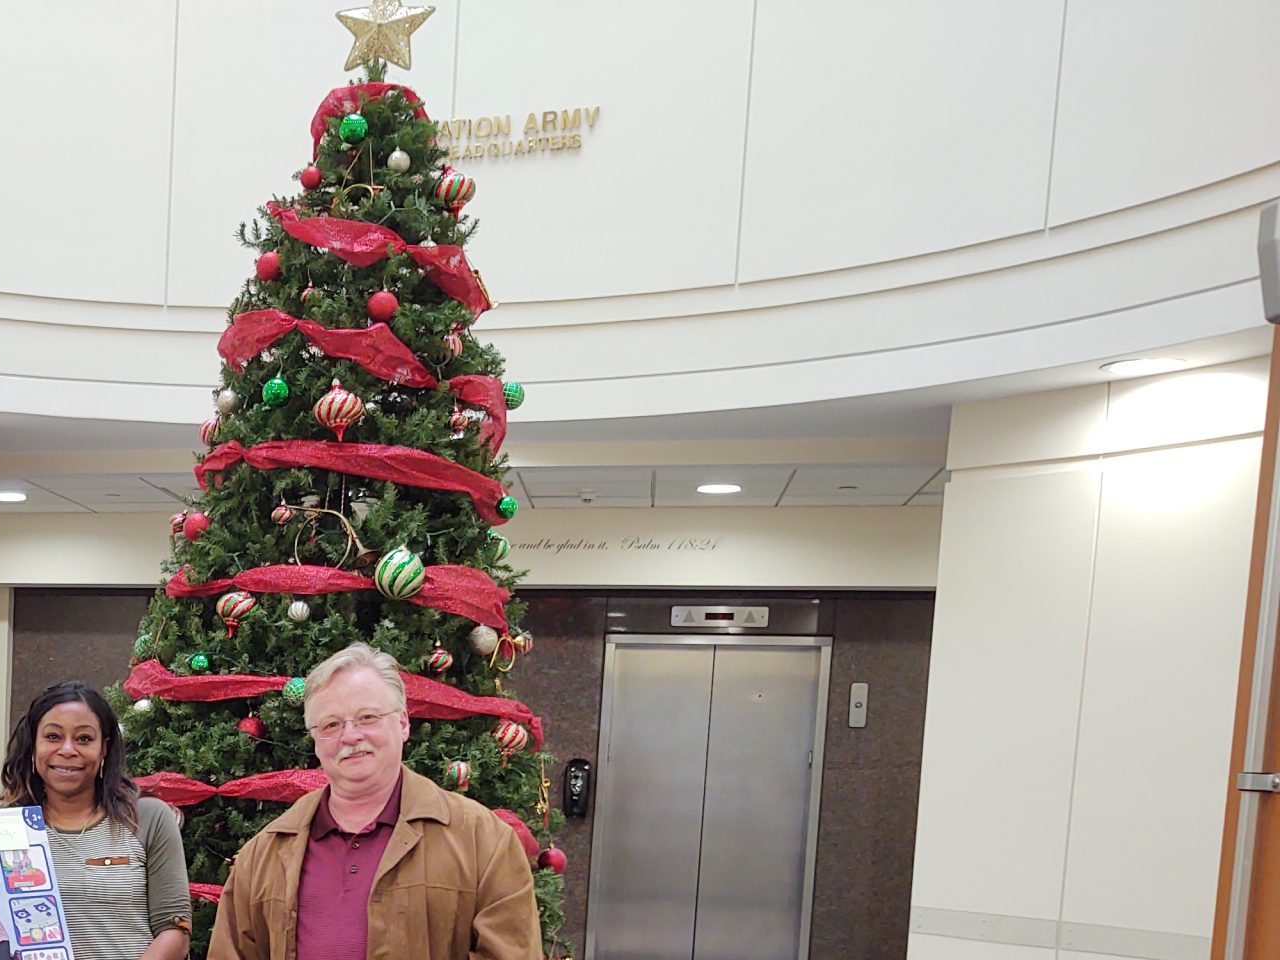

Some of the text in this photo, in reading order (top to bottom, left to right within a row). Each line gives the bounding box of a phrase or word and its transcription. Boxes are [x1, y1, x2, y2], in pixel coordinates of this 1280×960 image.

[437, 106, 601, 141] ATION ARMY
[446, 134, 583, 160] EADQUARTERS
[518, 538, 544, 550] and
[543, 538, 555, 550] be
[554, 538, 584, 555] glad
[583, 540, 595, 550] in
[620, 535, 660, 550] Psalm
